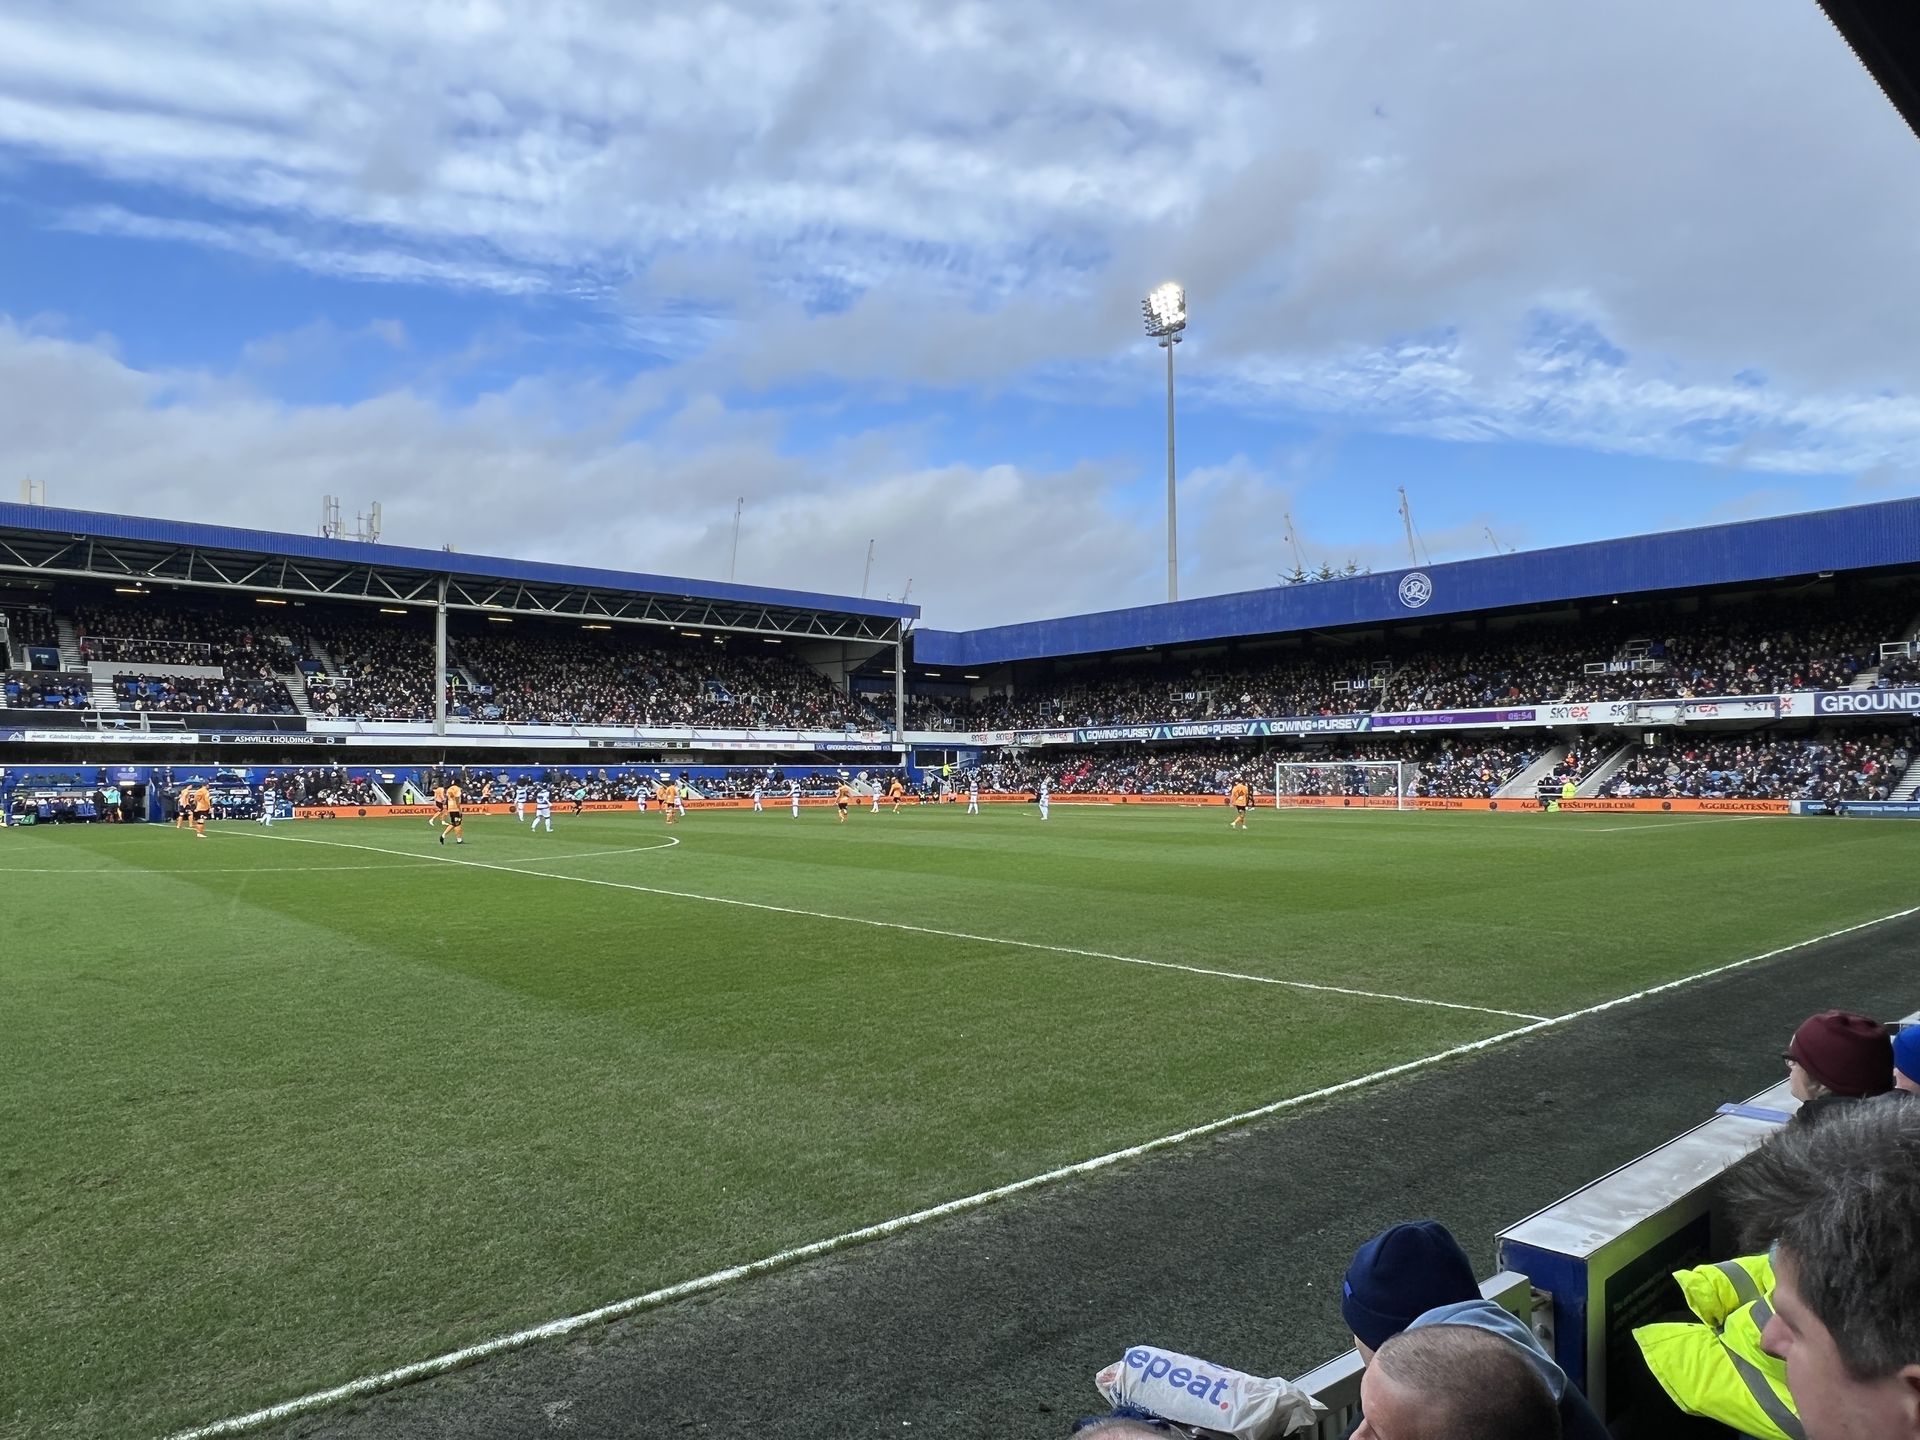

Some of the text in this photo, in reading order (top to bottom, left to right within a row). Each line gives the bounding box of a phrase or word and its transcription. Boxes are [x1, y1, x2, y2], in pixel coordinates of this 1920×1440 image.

[1609, 662, 1628, 671] MU
[1353, 680, 1365, 689] LU
[1185, 692, 1195, 700] KU
[1821, 692, 1920, 712] GROUND
[1172, 723, 1249, 736] GOWING PURSEY
[1270, 719, 1359, 732] GOWING PURSEY
[1086, 727, 1154, 739] GOWING PURSEY
[272, 736, 314, 744] HOLDINGS
[1126, 1349, 1229, 1410] epeat.
